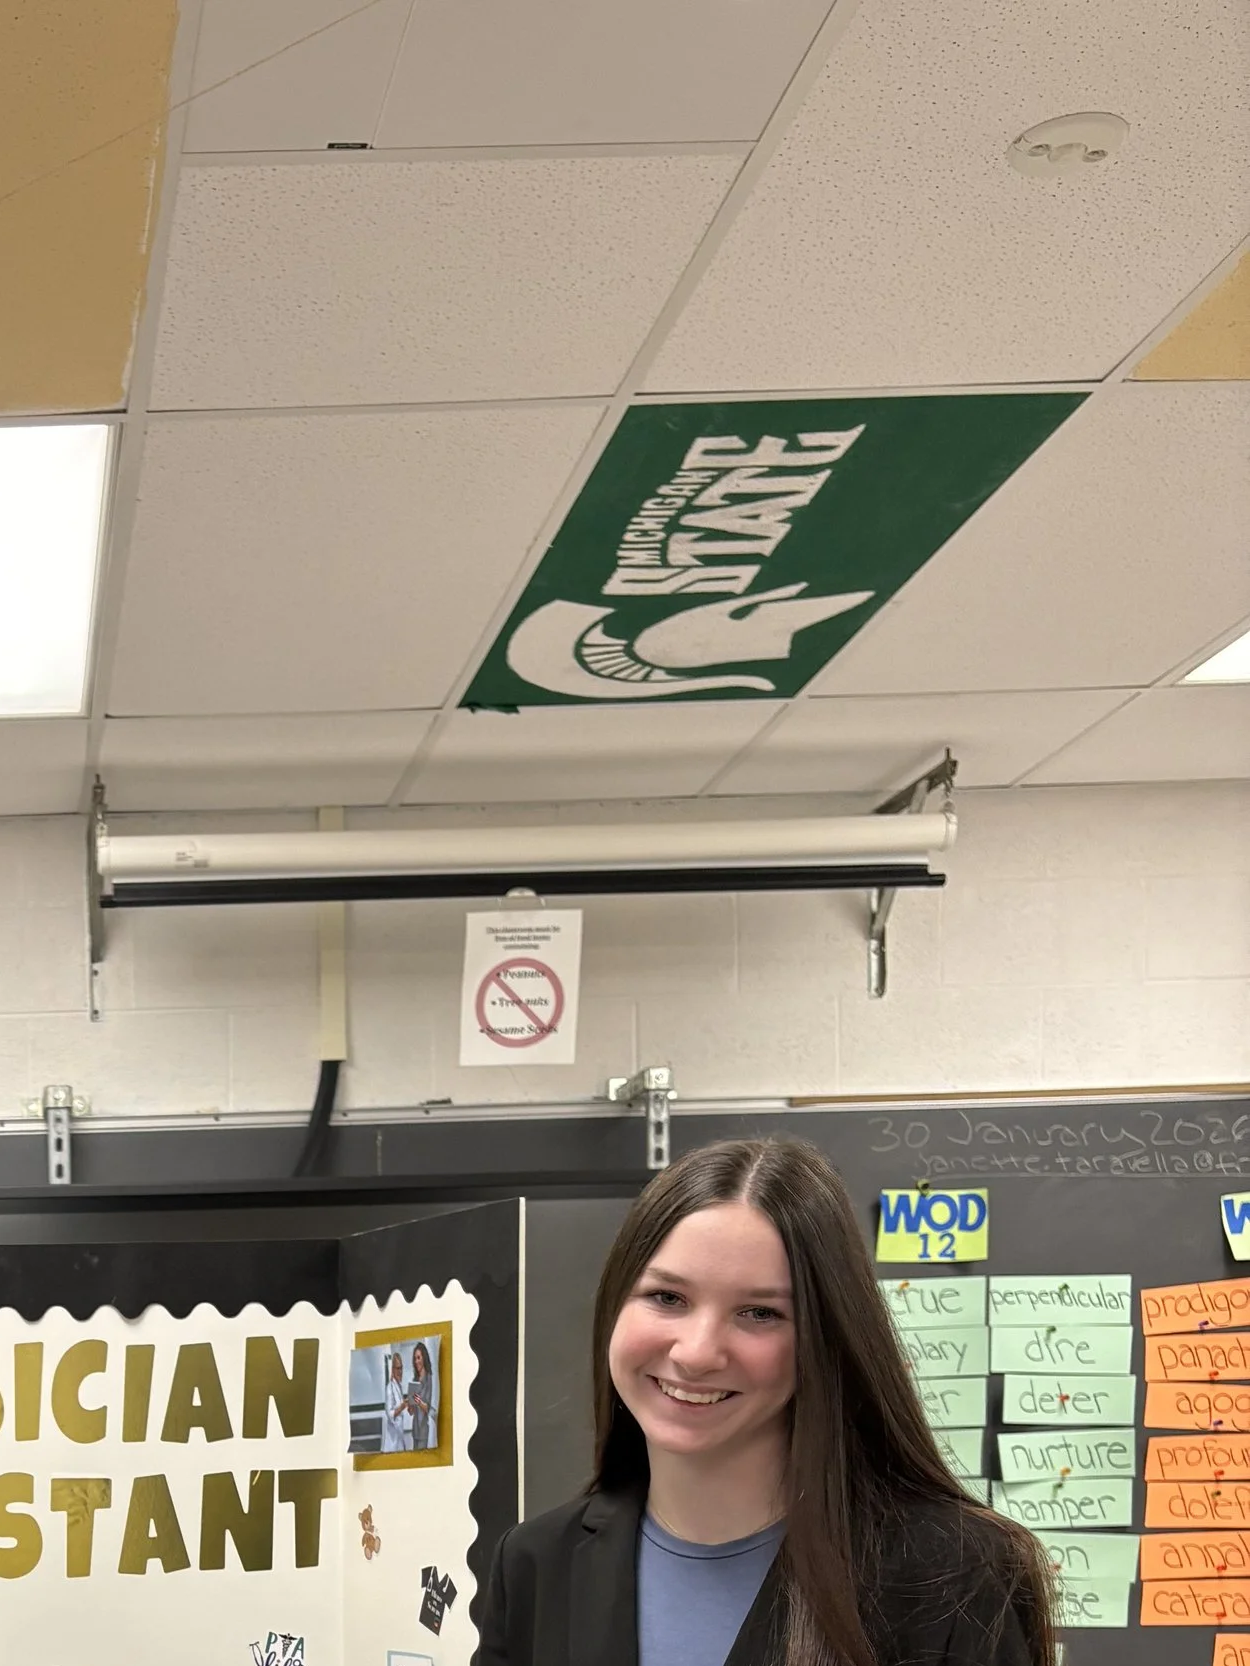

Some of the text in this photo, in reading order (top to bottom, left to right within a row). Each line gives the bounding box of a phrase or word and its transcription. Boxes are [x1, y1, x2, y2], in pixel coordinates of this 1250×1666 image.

[601, 423, 866, 595] STATE
[616, 468, 718, 566] MICHIGAN
[868, 1117, 931, 1153] 30
[947, 1111, 1147, 1161] January
[879, 1192, 988, 1235] WOD
[917, 1233, 958, 1260] 12
[989, 1281, 1131, 1314] perpendicular
[1024, 1330, 1096, 1365] dire
[1018, 1379, 1110, 1416] deter
[1010, 1435, 1132, 1471] nurture
[1001, 1485, 1116, 1528] hamper
[1048, 1545, 1091, 1571] on
